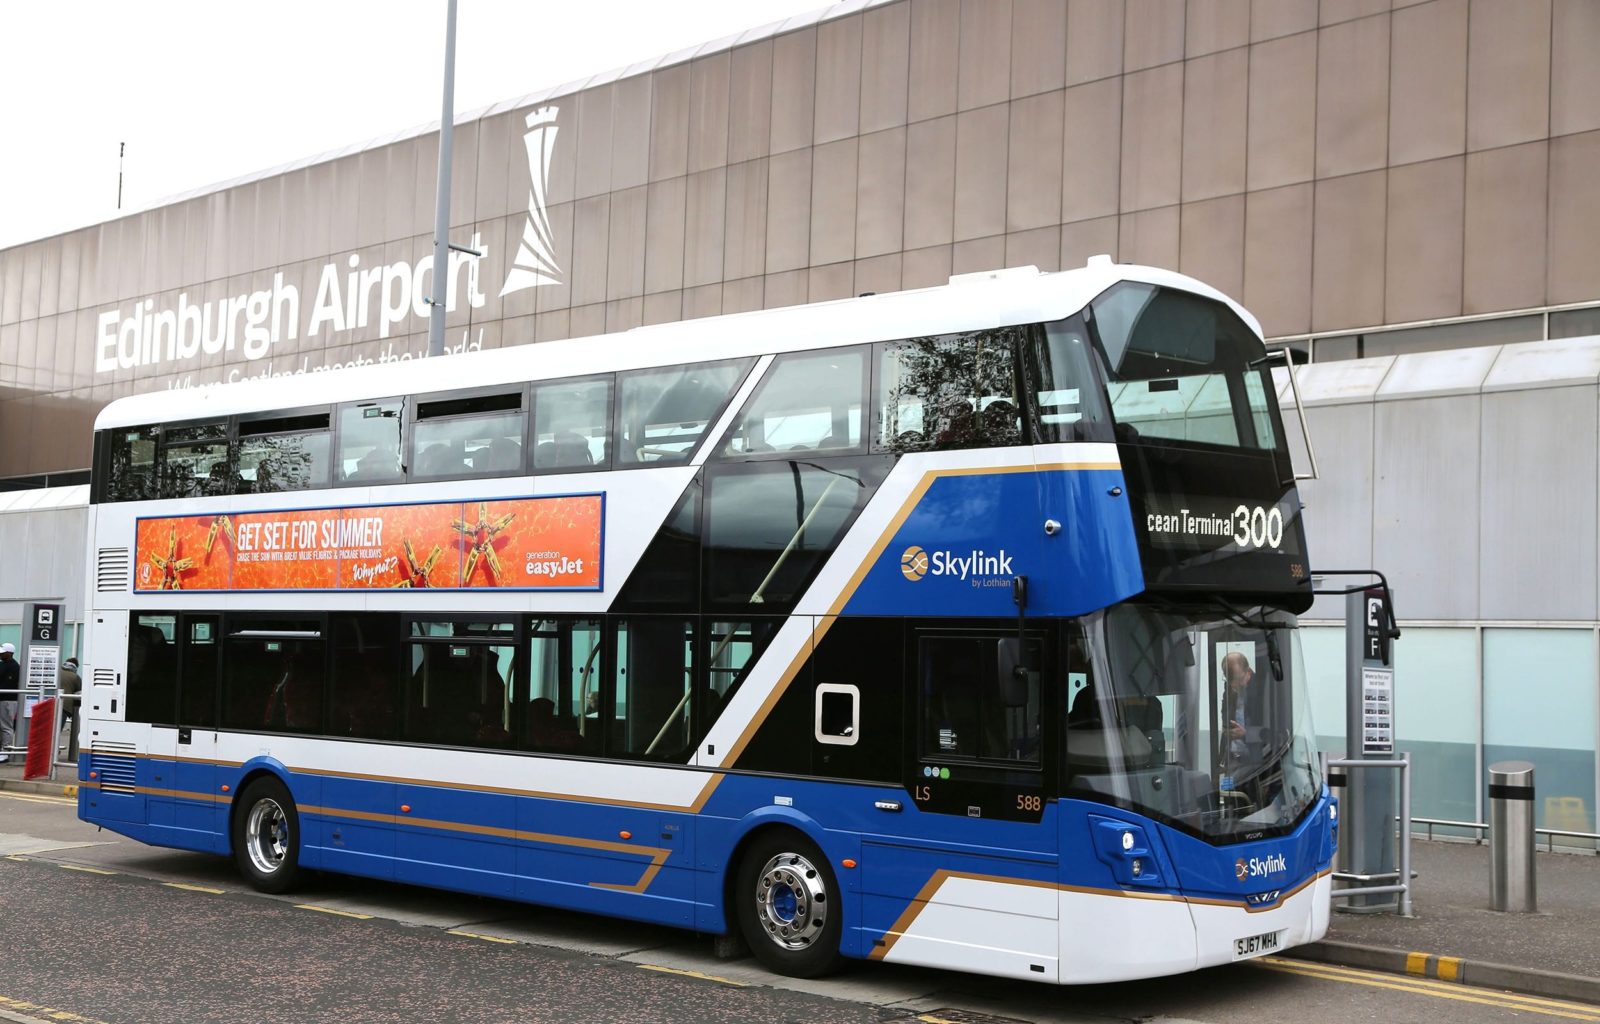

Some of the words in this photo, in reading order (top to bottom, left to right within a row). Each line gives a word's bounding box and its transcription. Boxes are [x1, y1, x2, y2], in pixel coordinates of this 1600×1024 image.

[96, 272, 298, 373] Edinburgh
[308, 232, 488, 338] Airport
[238, 522, 262, 551] GET
[263, 521, 290, 550] SET
[291, 519, 317, 549] FOR
[321, 517, 383, 548] SUMMER
[1180, 509, 1234, 536] Terminal
[1234, 505, 1283, 549] 300
[251, 552, 260, 561] THE
[260, 552, 270, 561] SUN
[271, 551, 283, 561] WITH
[526, 552, 560, 561] generation
[931, 550, 1013, 580] Skylink
[352, 563, 374, 585] Why
[374, 556, 398, 575] not?
[526, 557, 583, 577] easyJet
[971, 578, 981, 588] by
[983, 578, 1011, 587] Lothian
[40, 629, 50, 639] G
[1371, 637, 1379, 656] F
[915, 785, 931, 801] LS
[1016, 794, 1041, 812] 588
[1250, 853, 1287, 878] Skylink
[1237, 936, 1260, 955] SJ67
[1262, 931, 1278, 949] MHA
